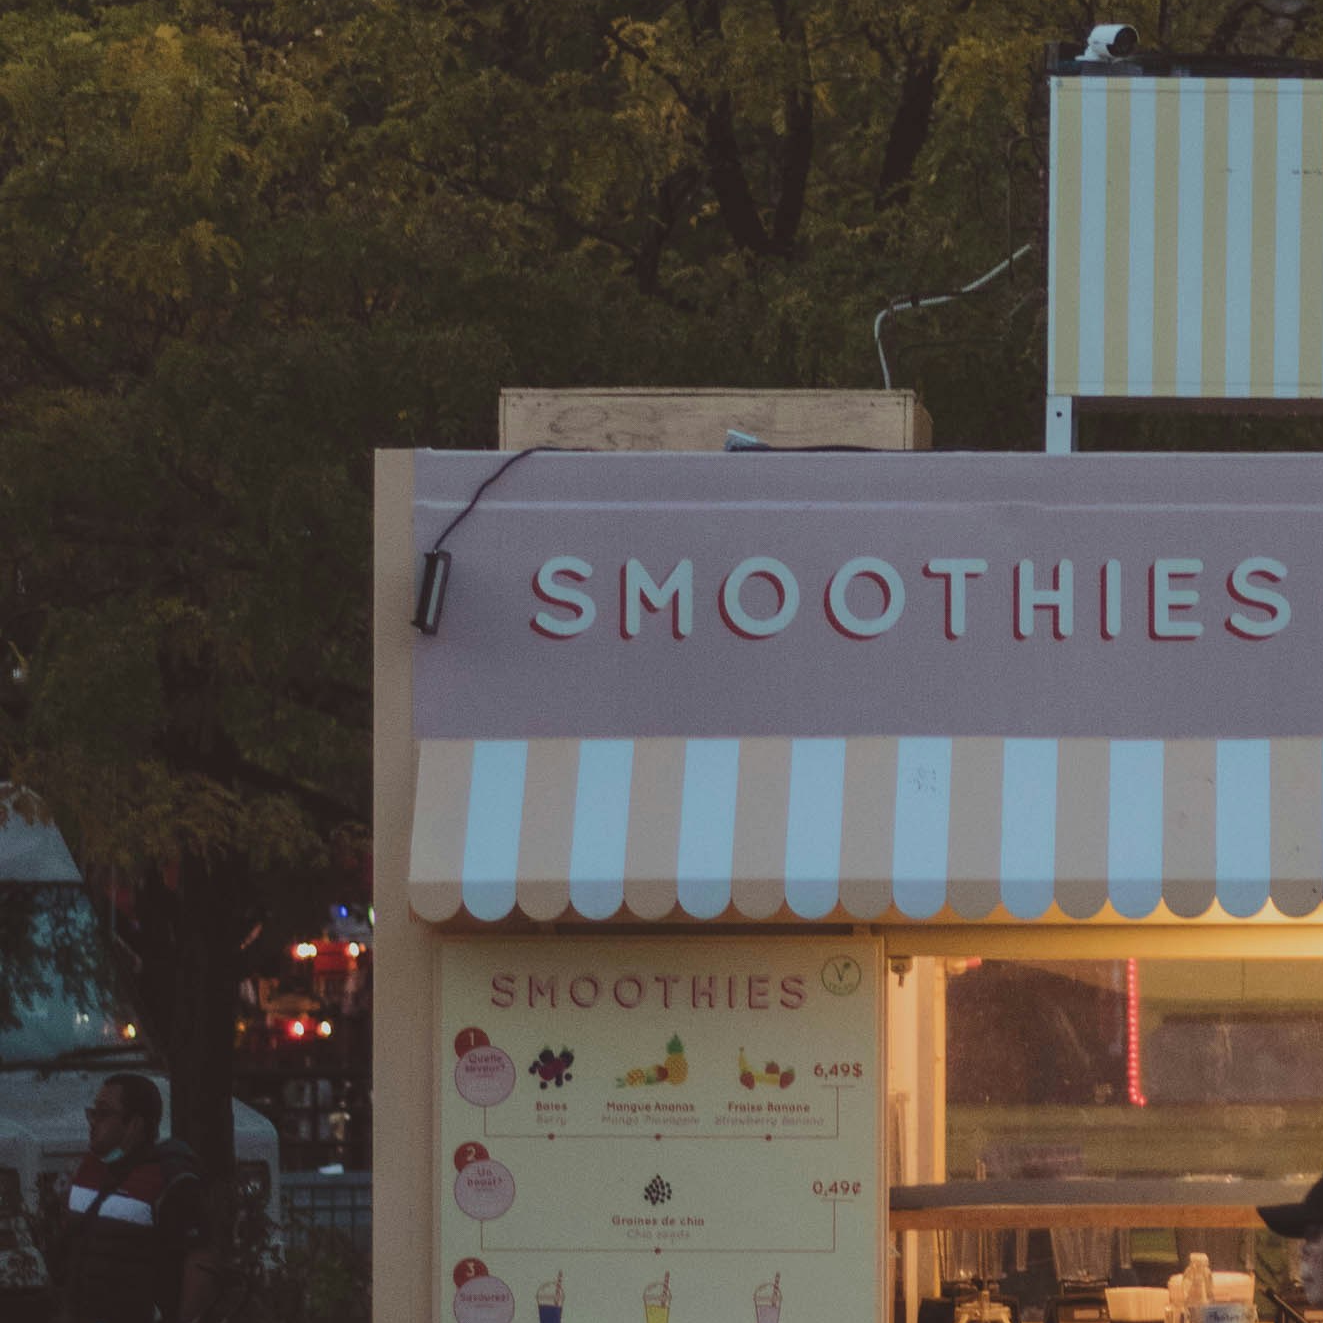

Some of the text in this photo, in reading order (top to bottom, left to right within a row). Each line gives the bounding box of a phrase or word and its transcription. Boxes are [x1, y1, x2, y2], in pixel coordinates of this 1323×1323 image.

[529, 555, 1292, 641] SMOOTHIES
[490, 974, 808, 1010] SMOOTHIES
[468, 1031, 475, 1046] 1
[813, 1062, 864, 1079] 6,49$
[535, 1100, 568, 1112] Baies
[606, 1101, 695, 1114] Mangue Ananas
[727, 1100, 811, 1112] Fraise Banane
[467, 1146, 476, 1161] 2
[611, 1214, 705, 1226] Graines de chia
[466, 1262, 475, 1277] 3
